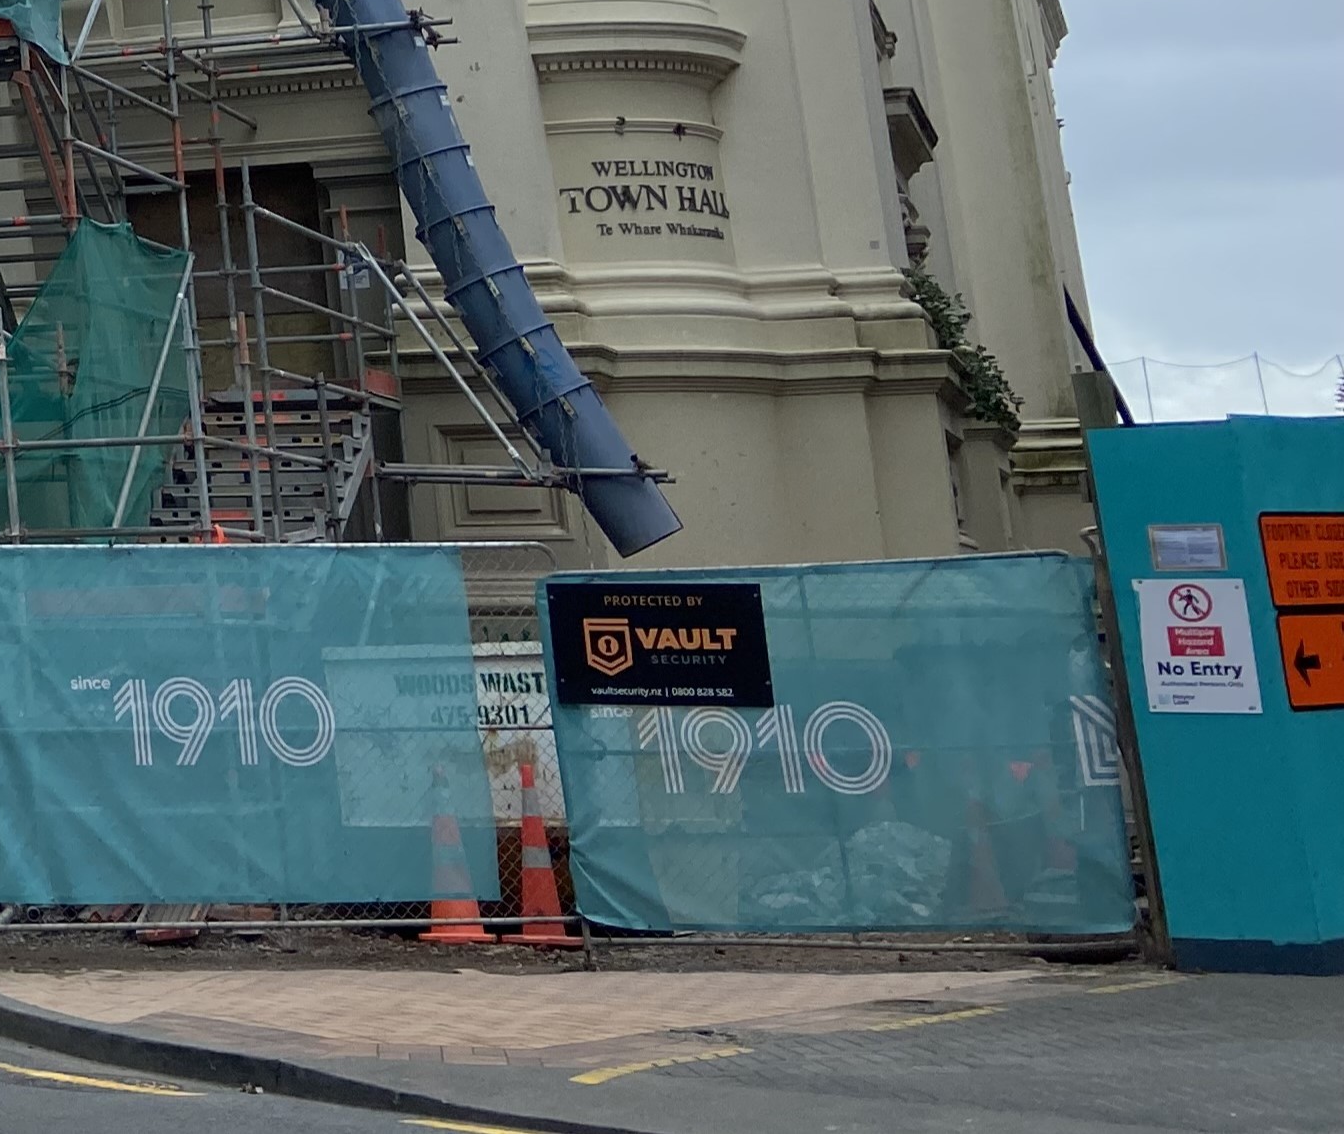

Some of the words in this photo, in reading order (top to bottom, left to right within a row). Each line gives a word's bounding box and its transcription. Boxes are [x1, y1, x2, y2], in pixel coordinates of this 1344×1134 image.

[591, 160, 714, 181] WELLINGTON
[559, 184, 668, 214] TOWN
[675, 185, 730, 220] HALL
[596, 223, 613, 236] Te
[618, 222, 662, 236] Whare
[1265, 523, 1311, 542] FOOTPATH
[1315, 523, 1344, 541] CLOSE
[1279, 551, 1321, 570] PLEASE
[1286, 579, 1321, 599] OTHER
[1326, 579, 1344, 598] SID
[604, 595, 682, 607] PROTECTED
[687, 595, 703, 607] BY
[635, 628, 737, 651] VAULT
[651, 655, 728, 666] SECURITY
[1185, 647, 1211, 657] Area
[1157, 661, 1185, 676] No
[1191, 661, 1244, 680] Entry
[393, 673, 473, 697] WOODS
[479, 672, 545, 695] WAST
[591, 686, 663, 699] vaultsecurity.nz
[672, 686, 695, 698] 0800
[697, 686, 714, 698] 828
[716, 687, 734, 699] 582
[70, 675, 112, 691] since
[113, 676, 336, 767] 1910
[590, 705, 634, 719] since
[637, 700, 893, 795] 1910
